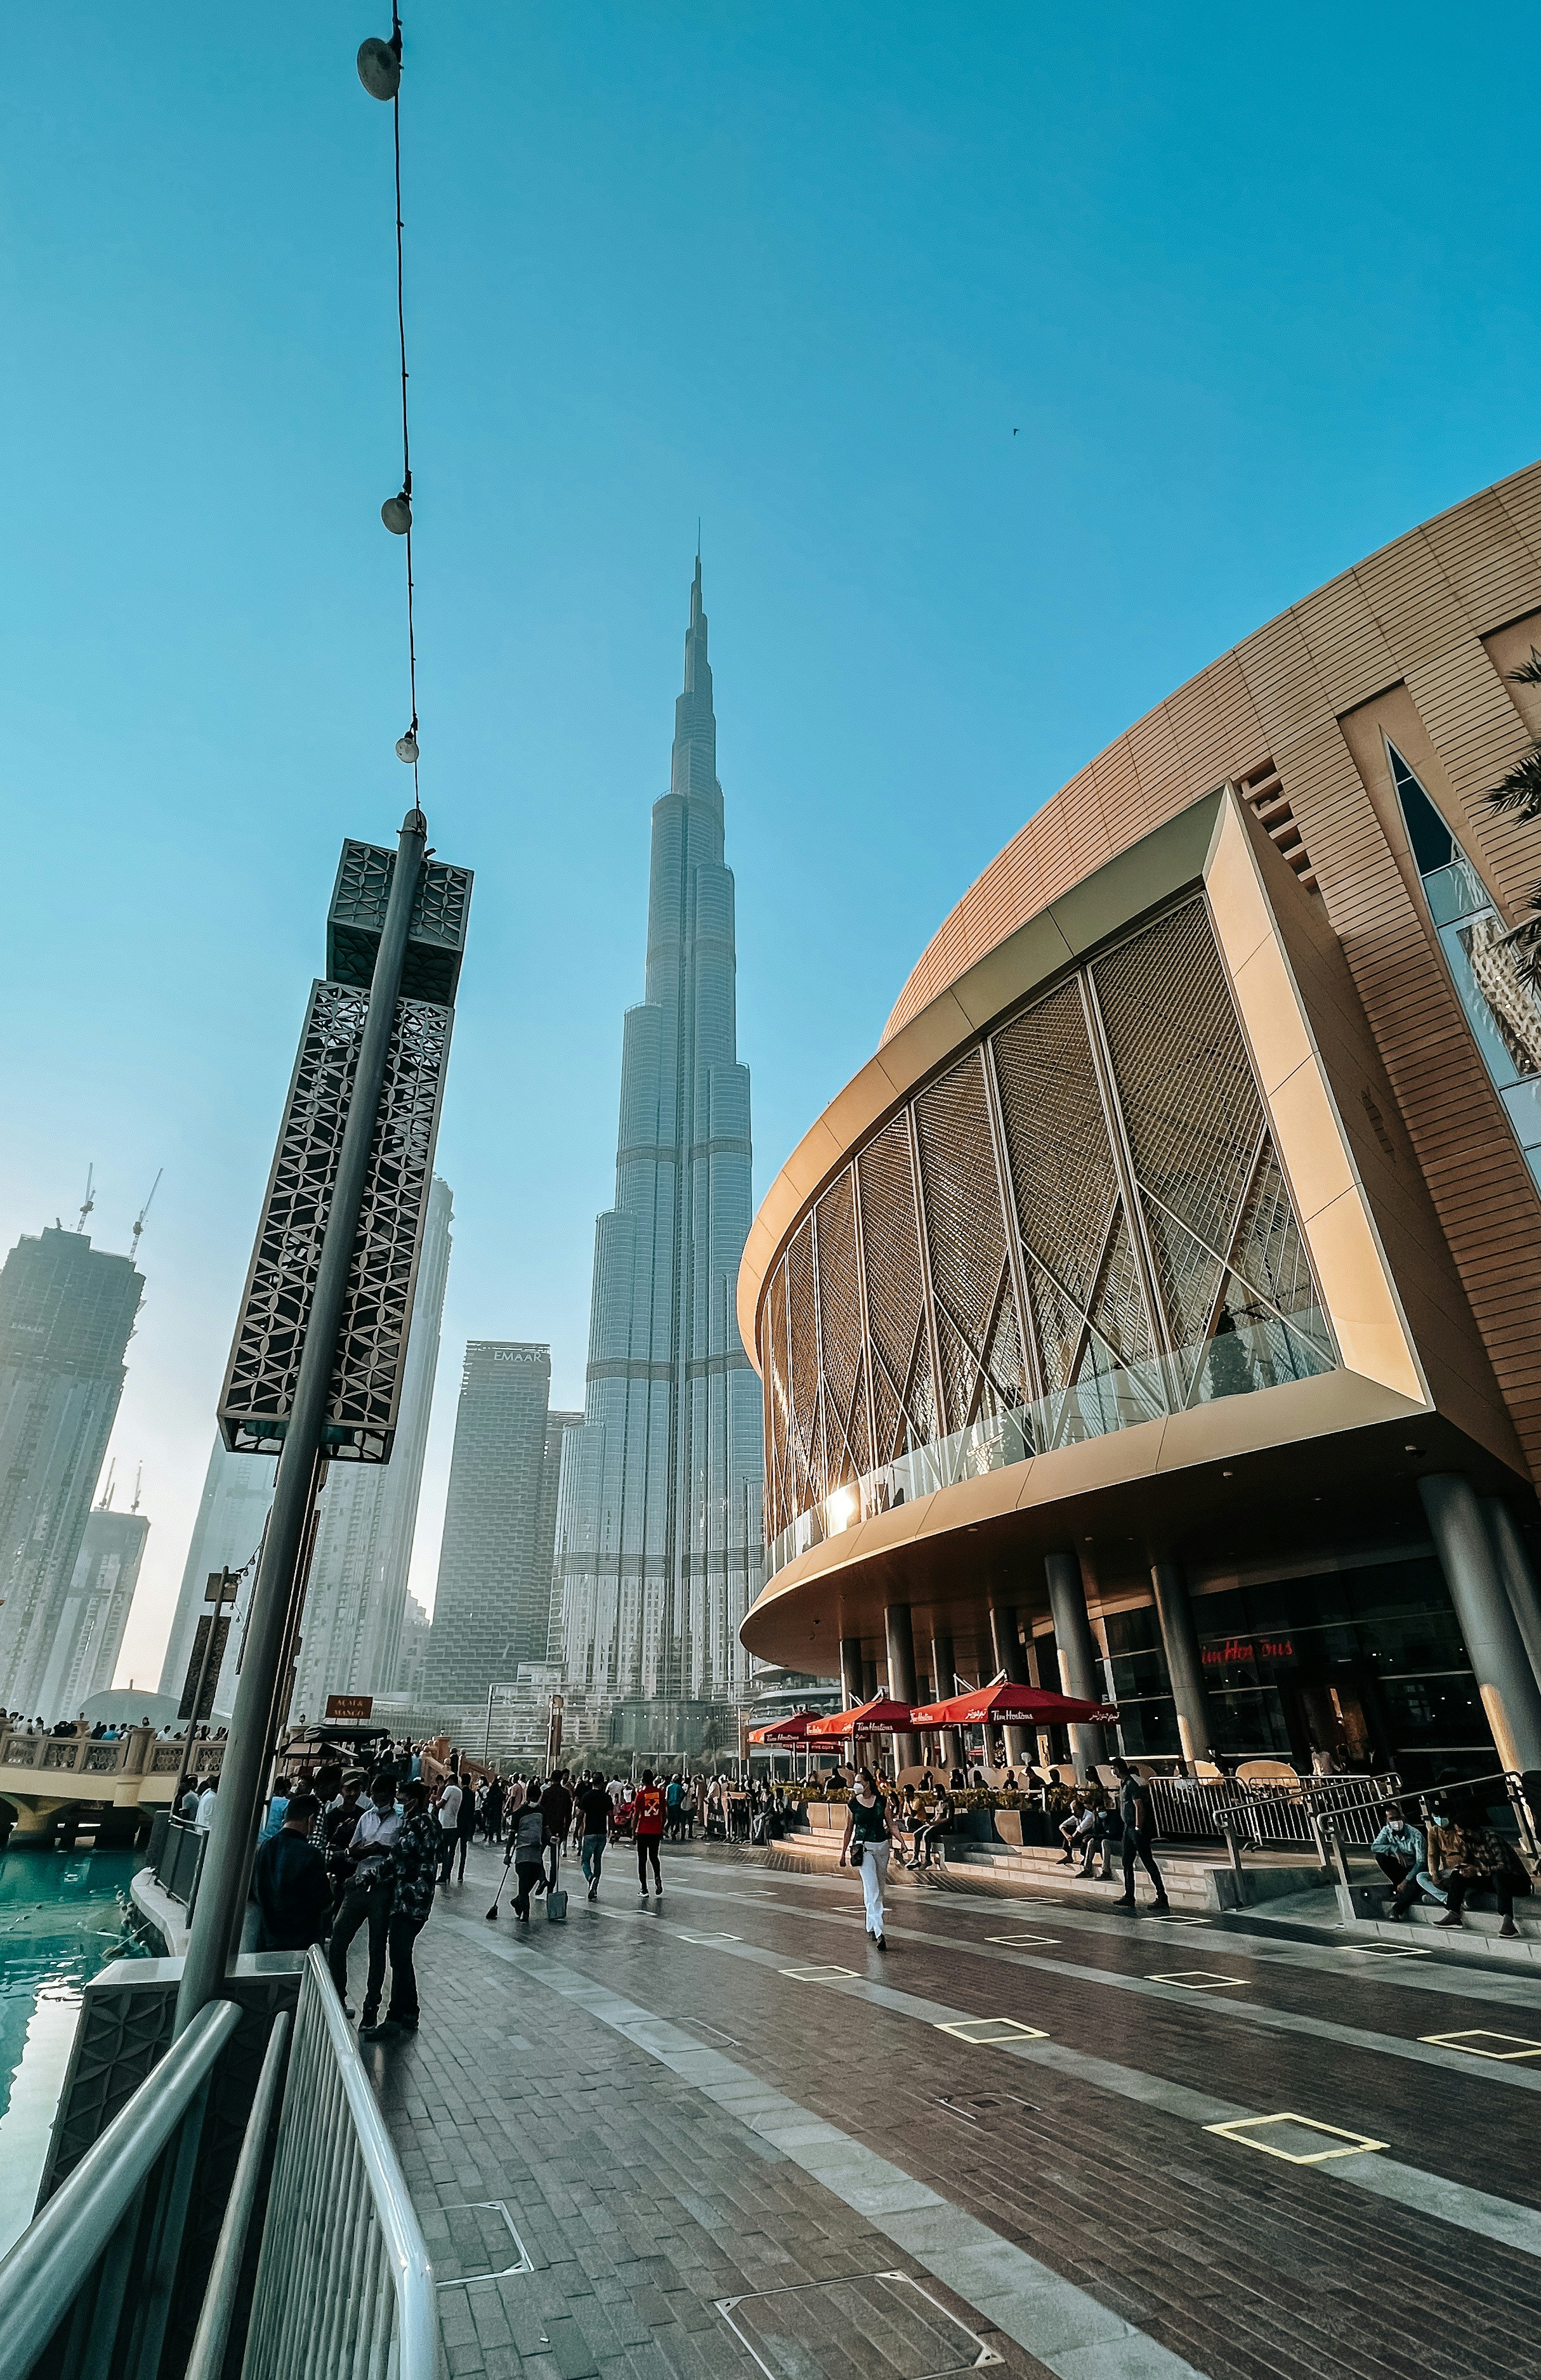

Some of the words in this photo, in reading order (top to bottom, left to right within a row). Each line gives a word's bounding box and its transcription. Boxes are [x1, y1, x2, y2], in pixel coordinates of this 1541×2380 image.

[494, 1350, 544, 1363] EMAAR
[991, 1710, 1006, 1721] Tim
[1006, 1710, 1033, 1720] Hortons
